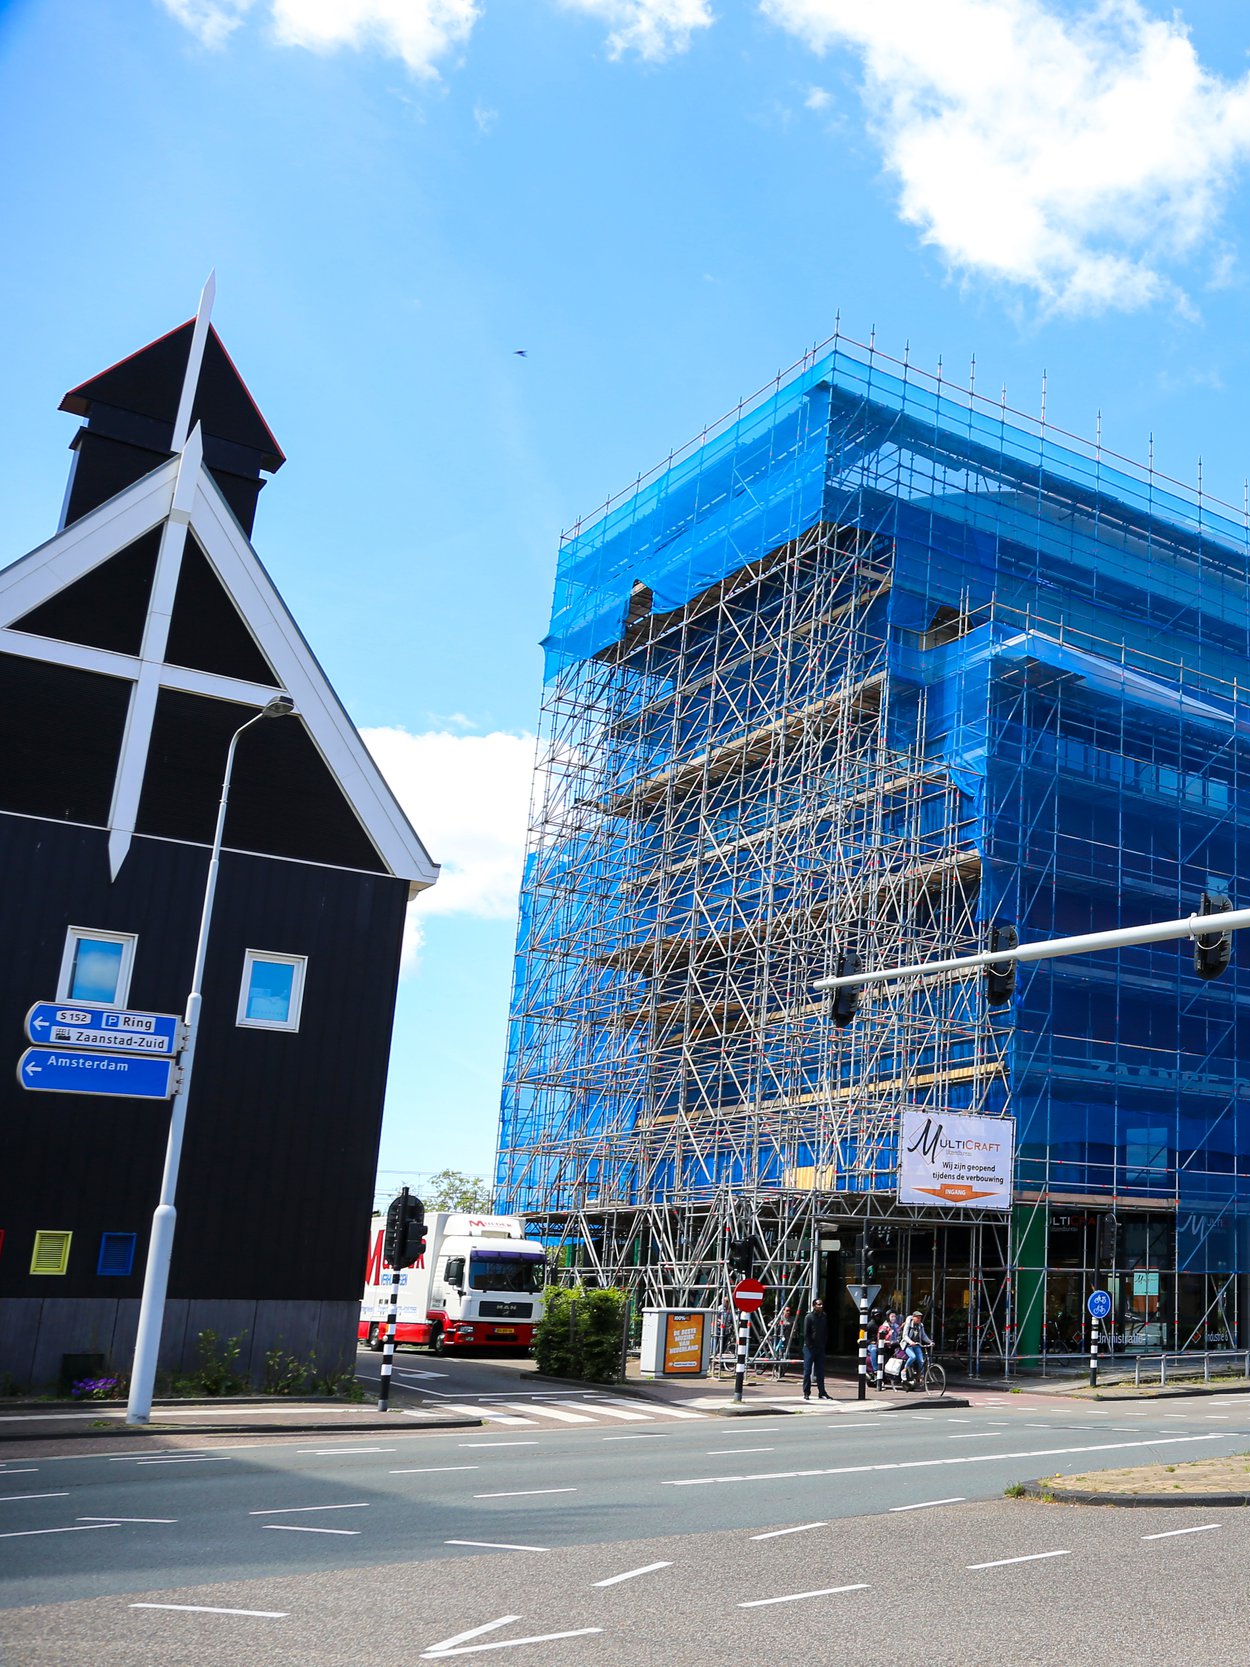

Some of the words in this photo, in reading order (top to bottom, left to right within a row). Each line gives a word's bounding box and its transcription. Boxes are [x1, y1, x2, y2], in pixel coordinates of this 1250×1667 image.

[69, 1013, 87, 1022] 152
[123, 1017, 152, 1031] Ring
[76, 1032, 165, 1049] Zaanstad-Zuid
[47, 1055, 128, 1071] Amsterdam
[907, 1118, 1001, 1164] MULTICRAFT
[942, 1162, 953, 1170] Wij
[954, 1163, 966, 1171] zijn
[967, 1164, 996, 1173] geopend
[932, 1172, 955, 1181] tijdens
[966, 1174, 1004, 1184] verbouwing
[945, 1188, 967, 1196] INGANG
